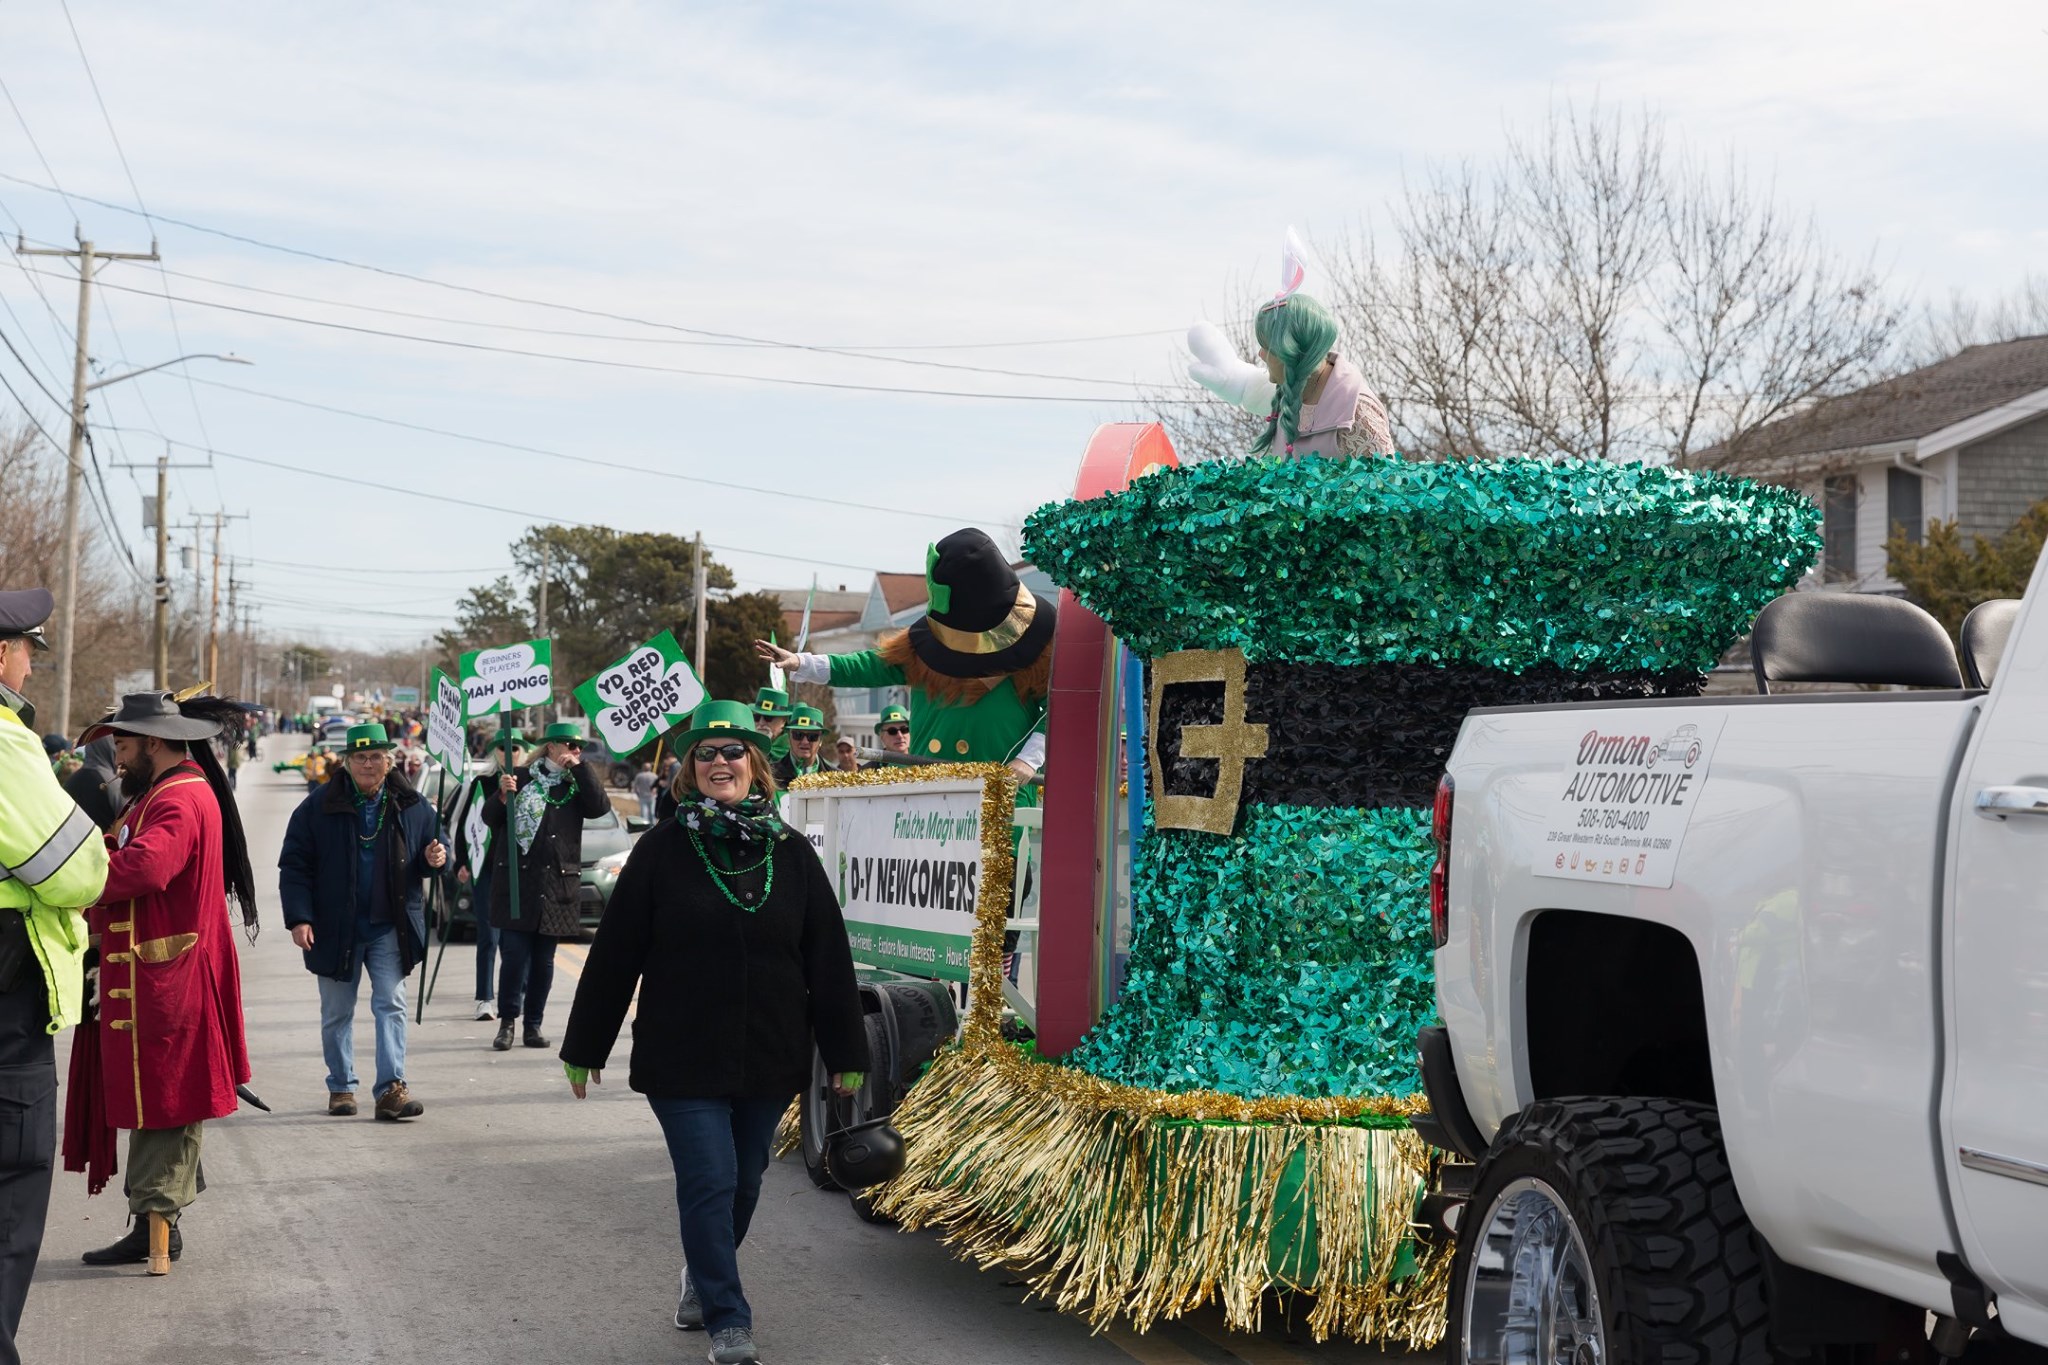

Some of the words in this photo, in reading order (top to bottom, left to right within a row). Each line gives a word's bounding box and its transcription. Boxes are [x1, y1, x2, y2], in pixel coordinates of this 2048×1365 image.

[482, 652, 521, 666] BEGINNERS
[489, 662, 520, 674] PLAYERS
[598, 674, 624, 694] YD
[628, 652, 659, 678] RED
[440, 682, 461, 712] THANK
[500, 674, 548, 692] JONGG
[621, 672, 656, 701] SOX
[441, 700, 456, 726] YOU!
[610, 673, 681, 726] SUPPORT
[628, 693, 679, 731] GROUP
[1562, 772, 1692, 805] AUTOMOTIVE
[911, 810, 924, 839] the
[956, 809, 977, 840] with
[1578, 808, 1650, 831] 508-760-4000
[807, 834, 824, 847] KI
[1558, 832, 1572, 843] Great
[1594, 834, 1602, 844] Rd
[1603, 835, 1620, 846] South
[1621, 836, 1640, 847] Dennis
[1642, 837, 1652, 848] MA
[851, 857, 874, 902] D-Y
[877, 858, 976, 914] NEWCOMERS
[879, 936, 896, 956] Explore
[897, 939, 908, 958] New
[910, 941, 935, 962] Interests
[946, 946, 962, 967] Have
